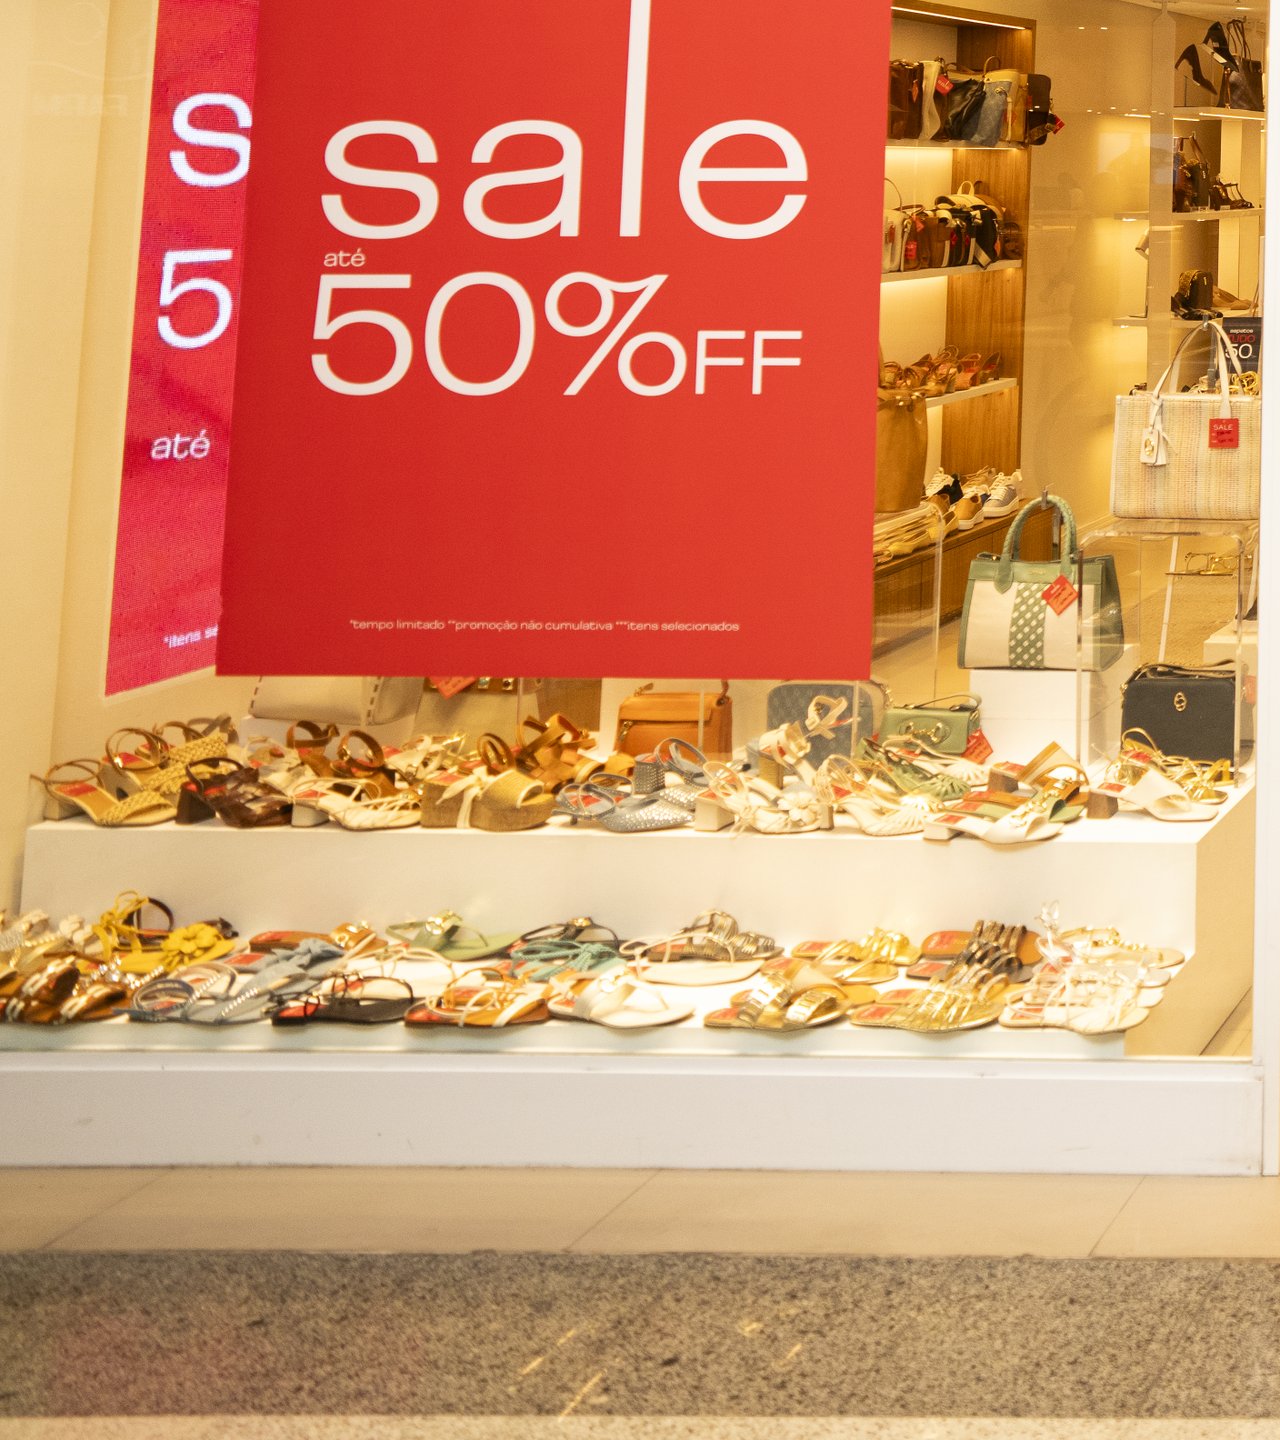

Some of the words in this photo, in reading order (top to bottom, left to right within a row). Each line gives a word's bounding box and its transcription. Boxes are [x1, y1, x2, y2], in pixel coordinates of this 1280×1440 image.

[324, 248, 366, 267] até
[150, 429, 211, 460] até
[396, 620, 445, 630] limitado
[520, 620, 543, 630] não
[545, 620, 613, 631] cumulativa
[661, 621, 740, 632] selecionados
